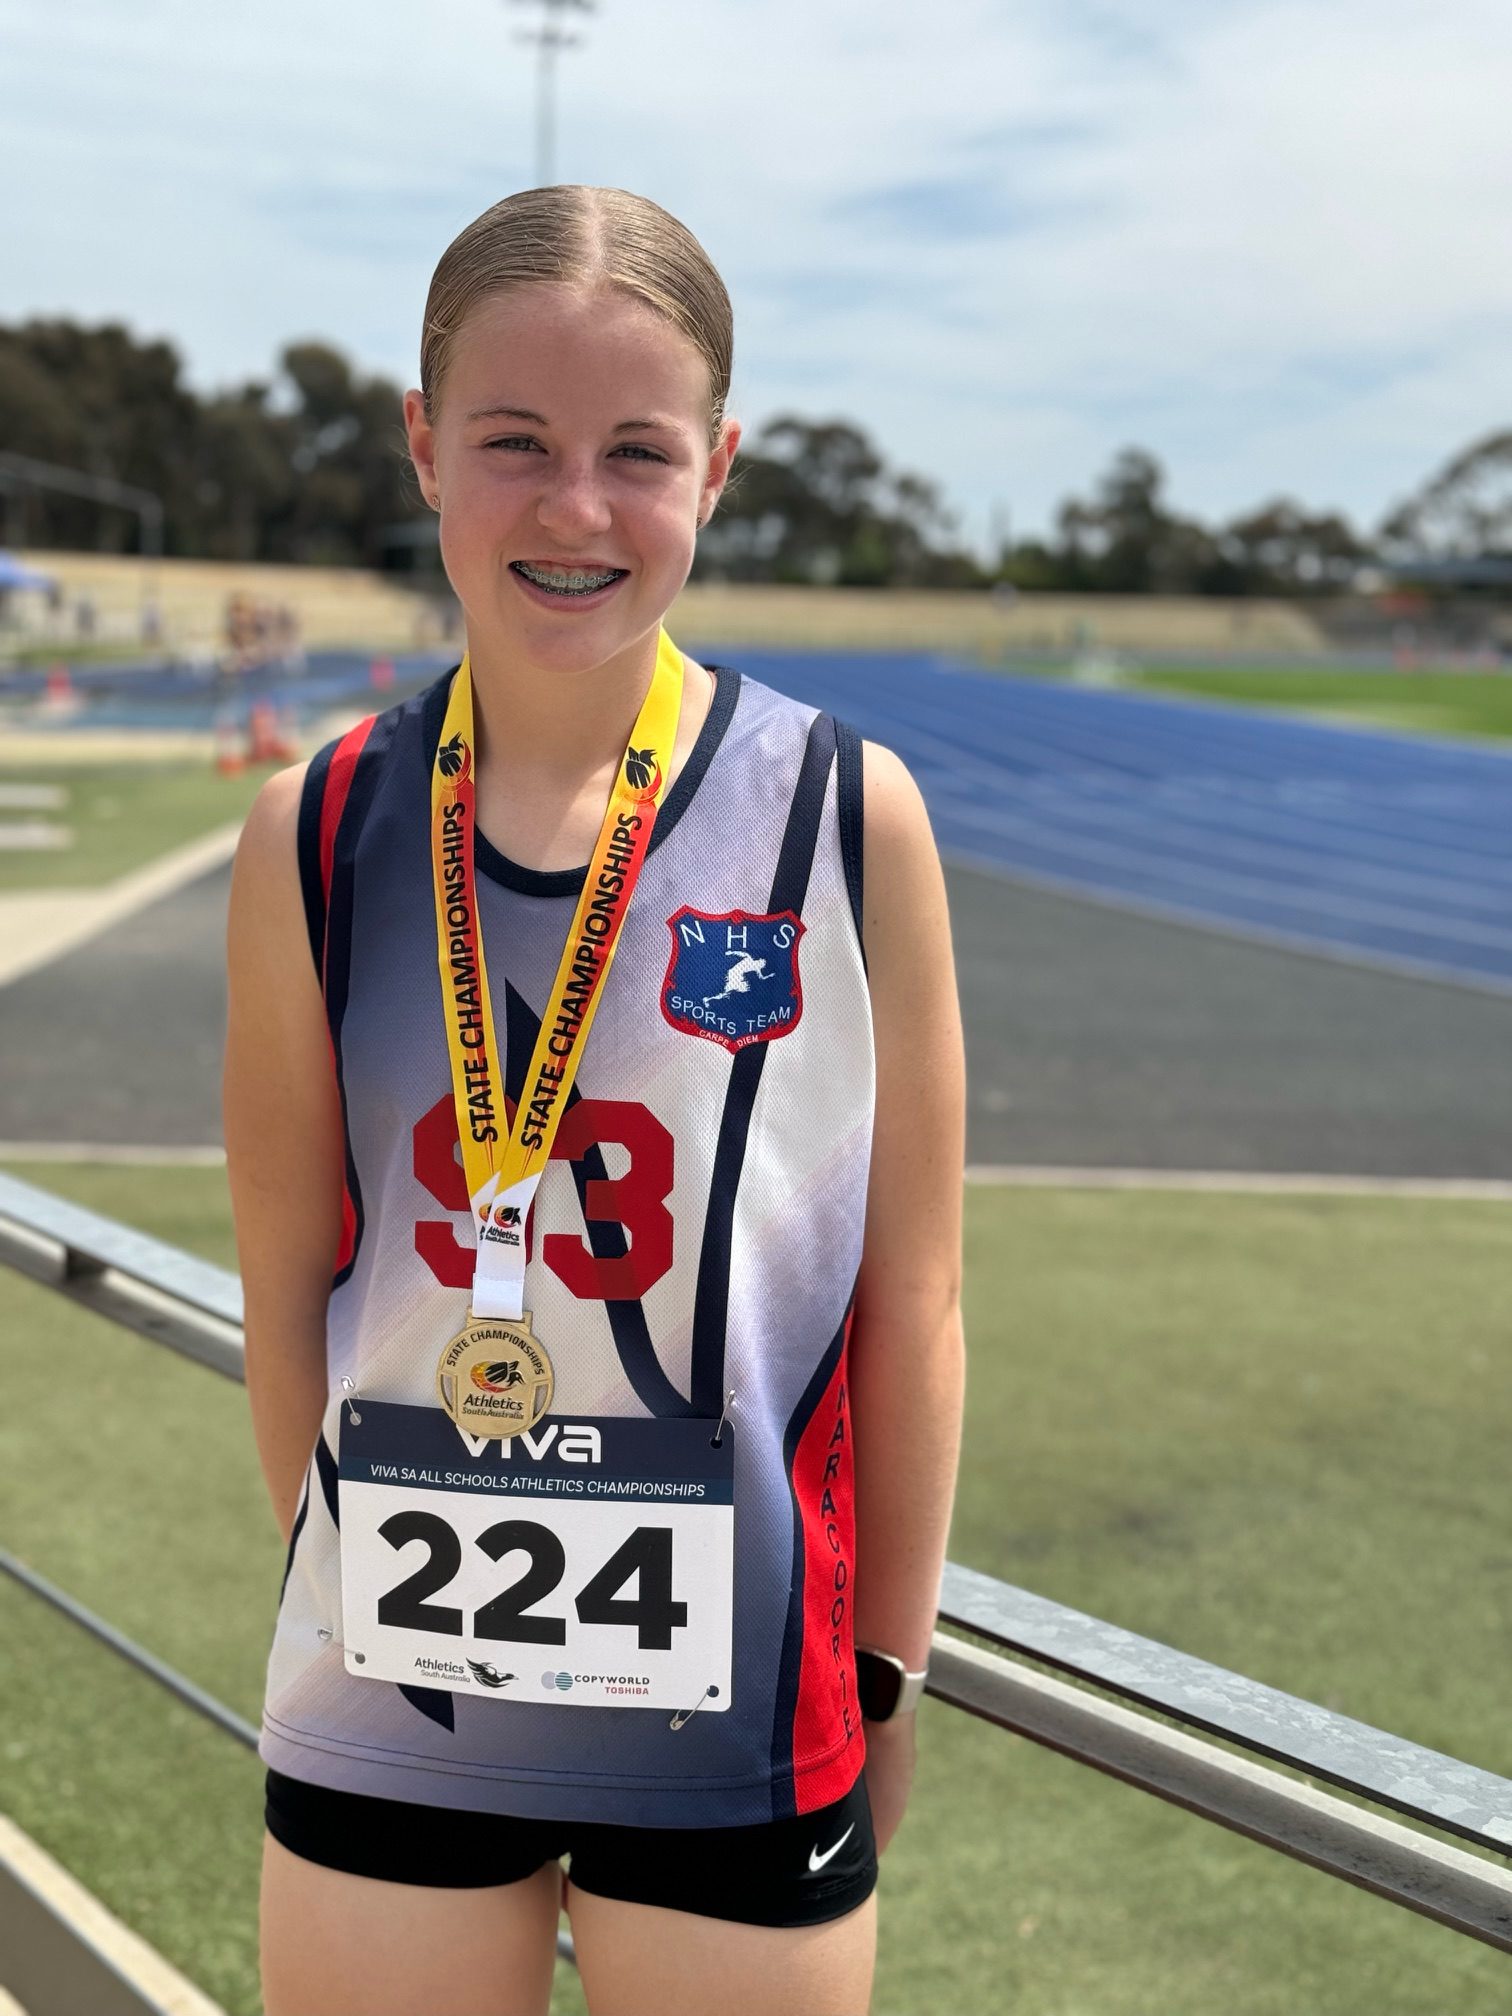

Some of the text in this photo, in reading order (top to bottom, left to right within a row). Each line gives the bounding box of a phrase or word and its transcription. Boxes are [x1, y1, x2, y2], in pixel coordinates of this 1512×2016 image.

[443, 801, 498, 1143] STATE CHAMPIONSHIPS
[520, 812, 643, 1150] STATE CHAMPIONSHIPS
[671, 996, 791, 1035] SPORTS TEAM
[699, 1029, 759, 1048] CARPE DIEM
[486, 1226, 520, 1242] Athletics
[446, 1329, 545, 1375] STATE CHAMPIONSHIPS
[463, 1393, 525, 1411] Athletics
[370, 1464, 706, 1497] VIVA SA ALL SCHOOLS ATHLETICS CHAMPIONSHIPS
[377, 1510, 688, 1651] 224
[414, 1657, 465, 1675] Athletics
[420, 1669, 471, 1684] South Australia
[574, 1674, 650, 1685] COPYWORLD
[605, 1686, 650, 1696] TOSHIBA
